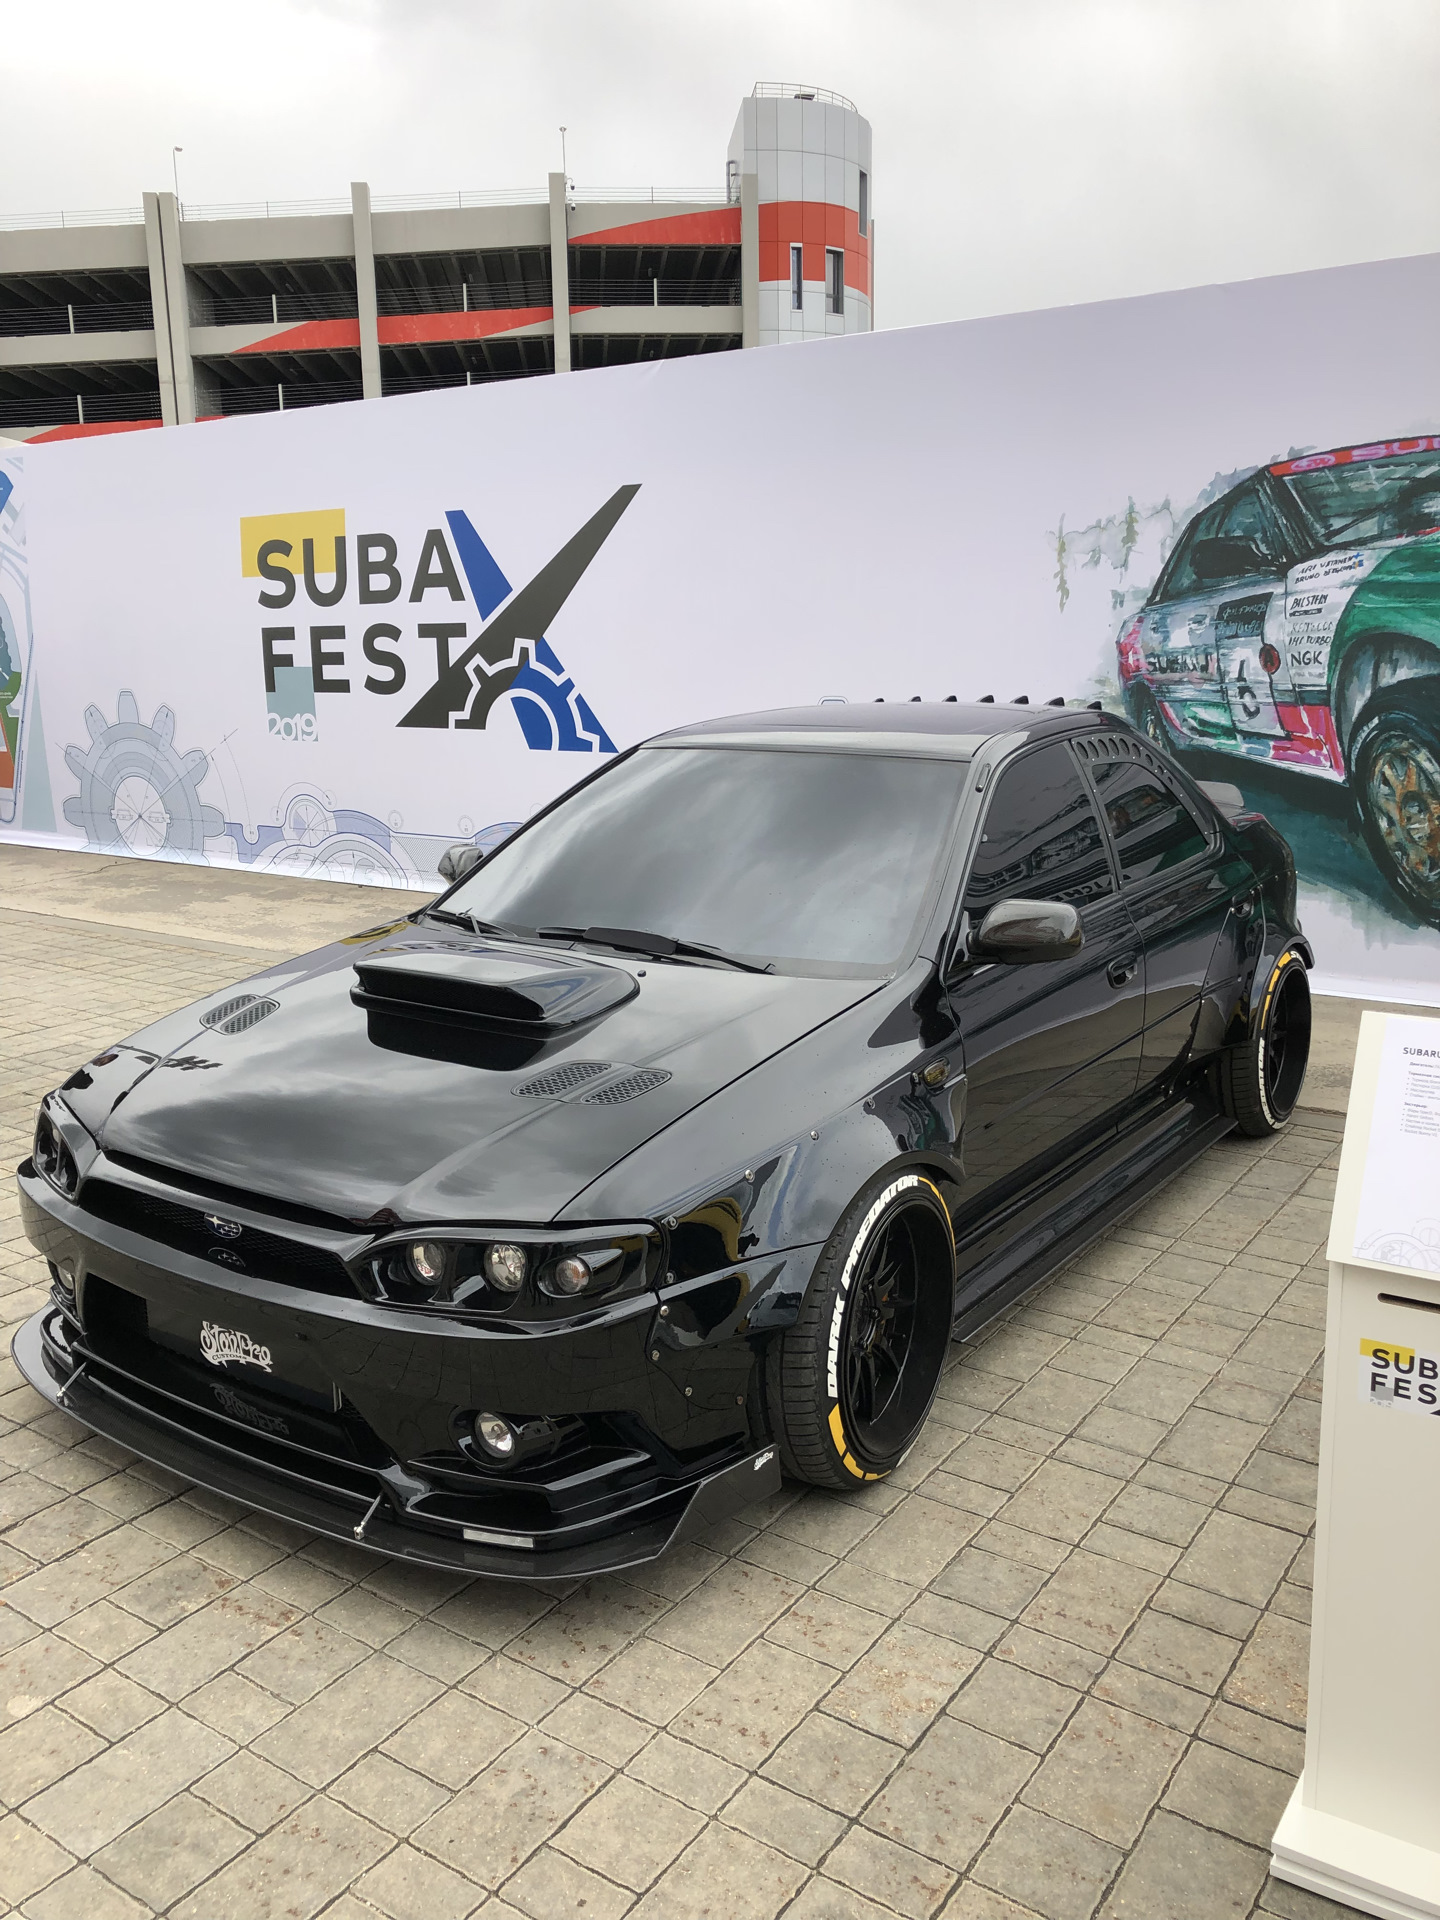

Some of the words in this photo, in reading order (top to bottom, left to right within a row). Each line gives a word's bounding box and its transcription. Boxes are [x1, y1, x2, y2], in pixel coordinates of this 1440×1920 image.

[261, 623, 468, 695] FEST
[1291, 650, 1322, 667] NGK
[268, 713, 318, 741] 2019
[827, 1292, 845, 1398] DARK
[841, 1175, 918, 1291] PREDATOR
